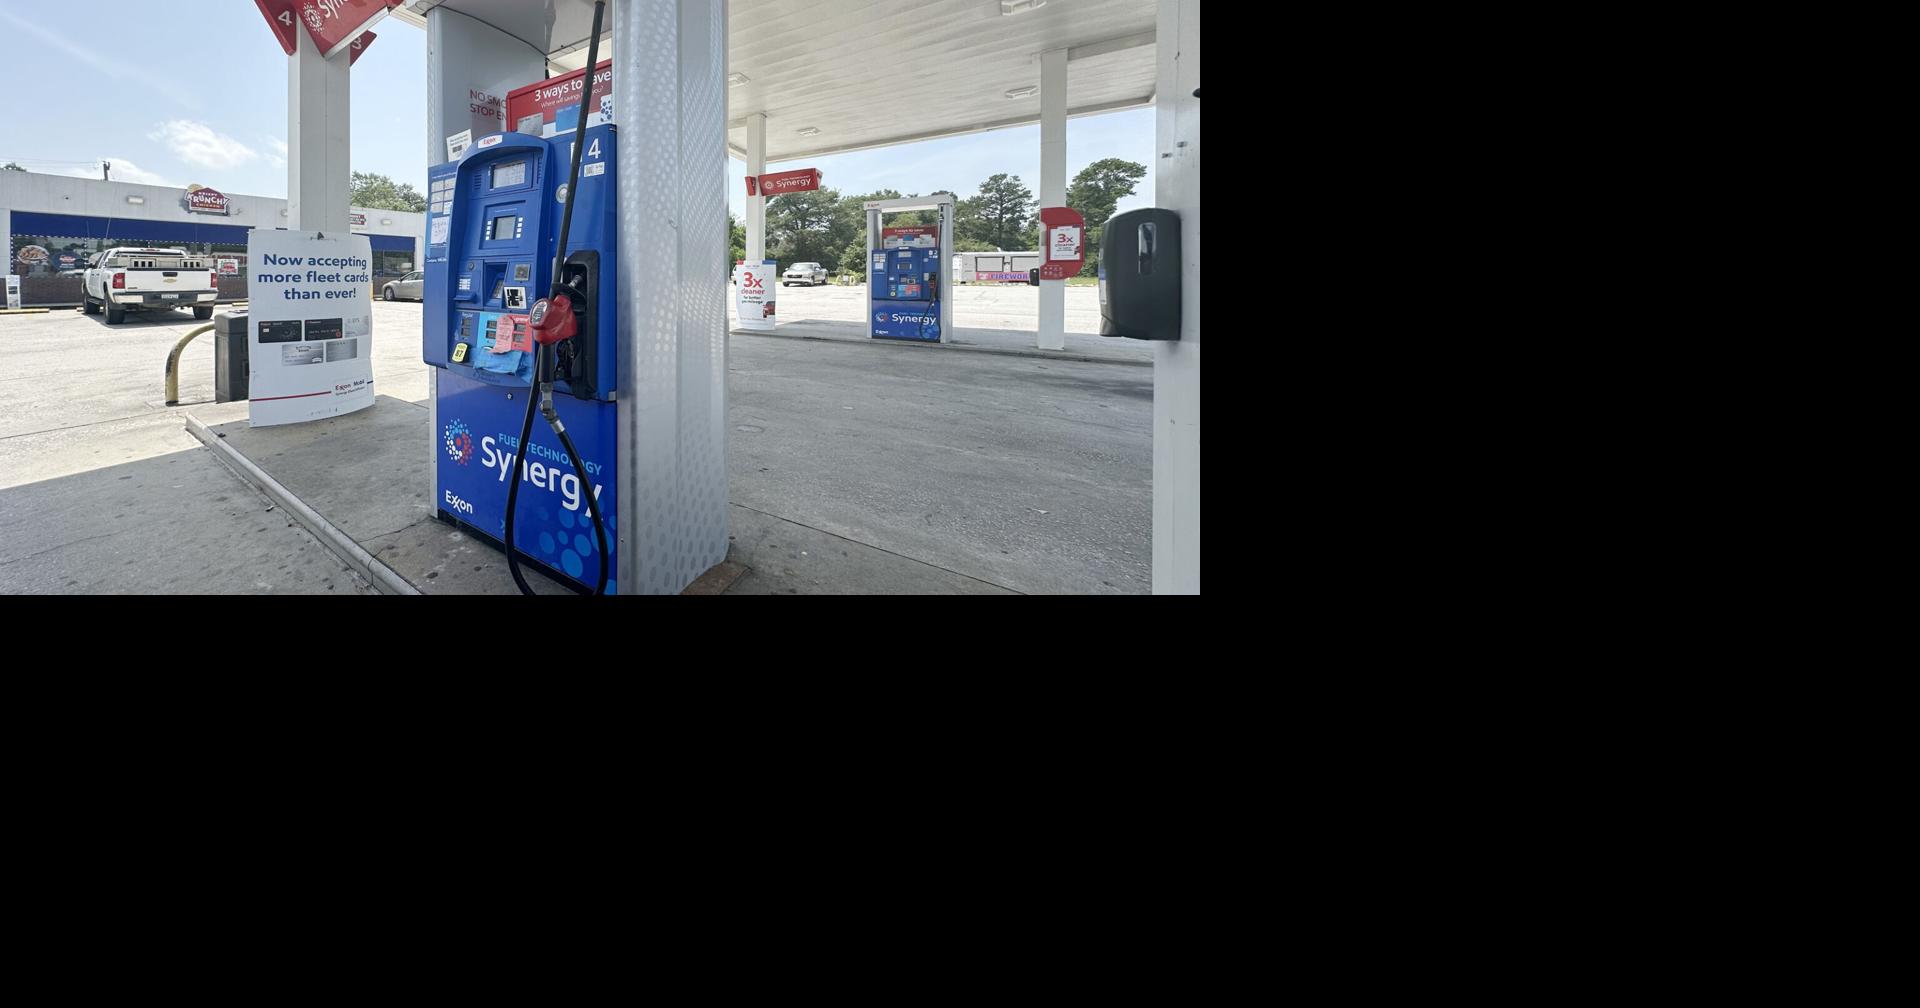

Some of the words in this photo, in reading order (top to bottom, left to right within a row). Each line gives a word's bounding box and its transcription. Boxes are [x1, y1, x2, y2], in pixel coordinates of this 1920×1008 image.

[278, 10, 293, 26] 4
[534, 89, 541, 102] 3
[543, 83, 569, 99] ways
[571, 79, 583, 91] to
[592, 70, 612, 85] ave
[469, 88, 486, 102] NO
[470, 103, 495, 117] STOP
[587, 137, 601, 159] 4
[776, 178, 811, 188] Synergy
[186, 192, 228, 205] KRUNCHY
[1057, 233, 1074, 243] 3x
[263, 253, 303, 266] Now
[307, 256, 367, 269] accepting
[258, 274, 302, 283] more
[306, 271, 341, 283] fleet
[344, 272, 369, 283] cards
[743, 271, 763, 288] 3x
[284, 288, 321, 300] than
[325, 288, 356, 299] ever!
[891, 313, 937, 326] Synergy
[526, 442, 602, 476] TECHNOGY
[445, 489, 473, 515] Exxon
